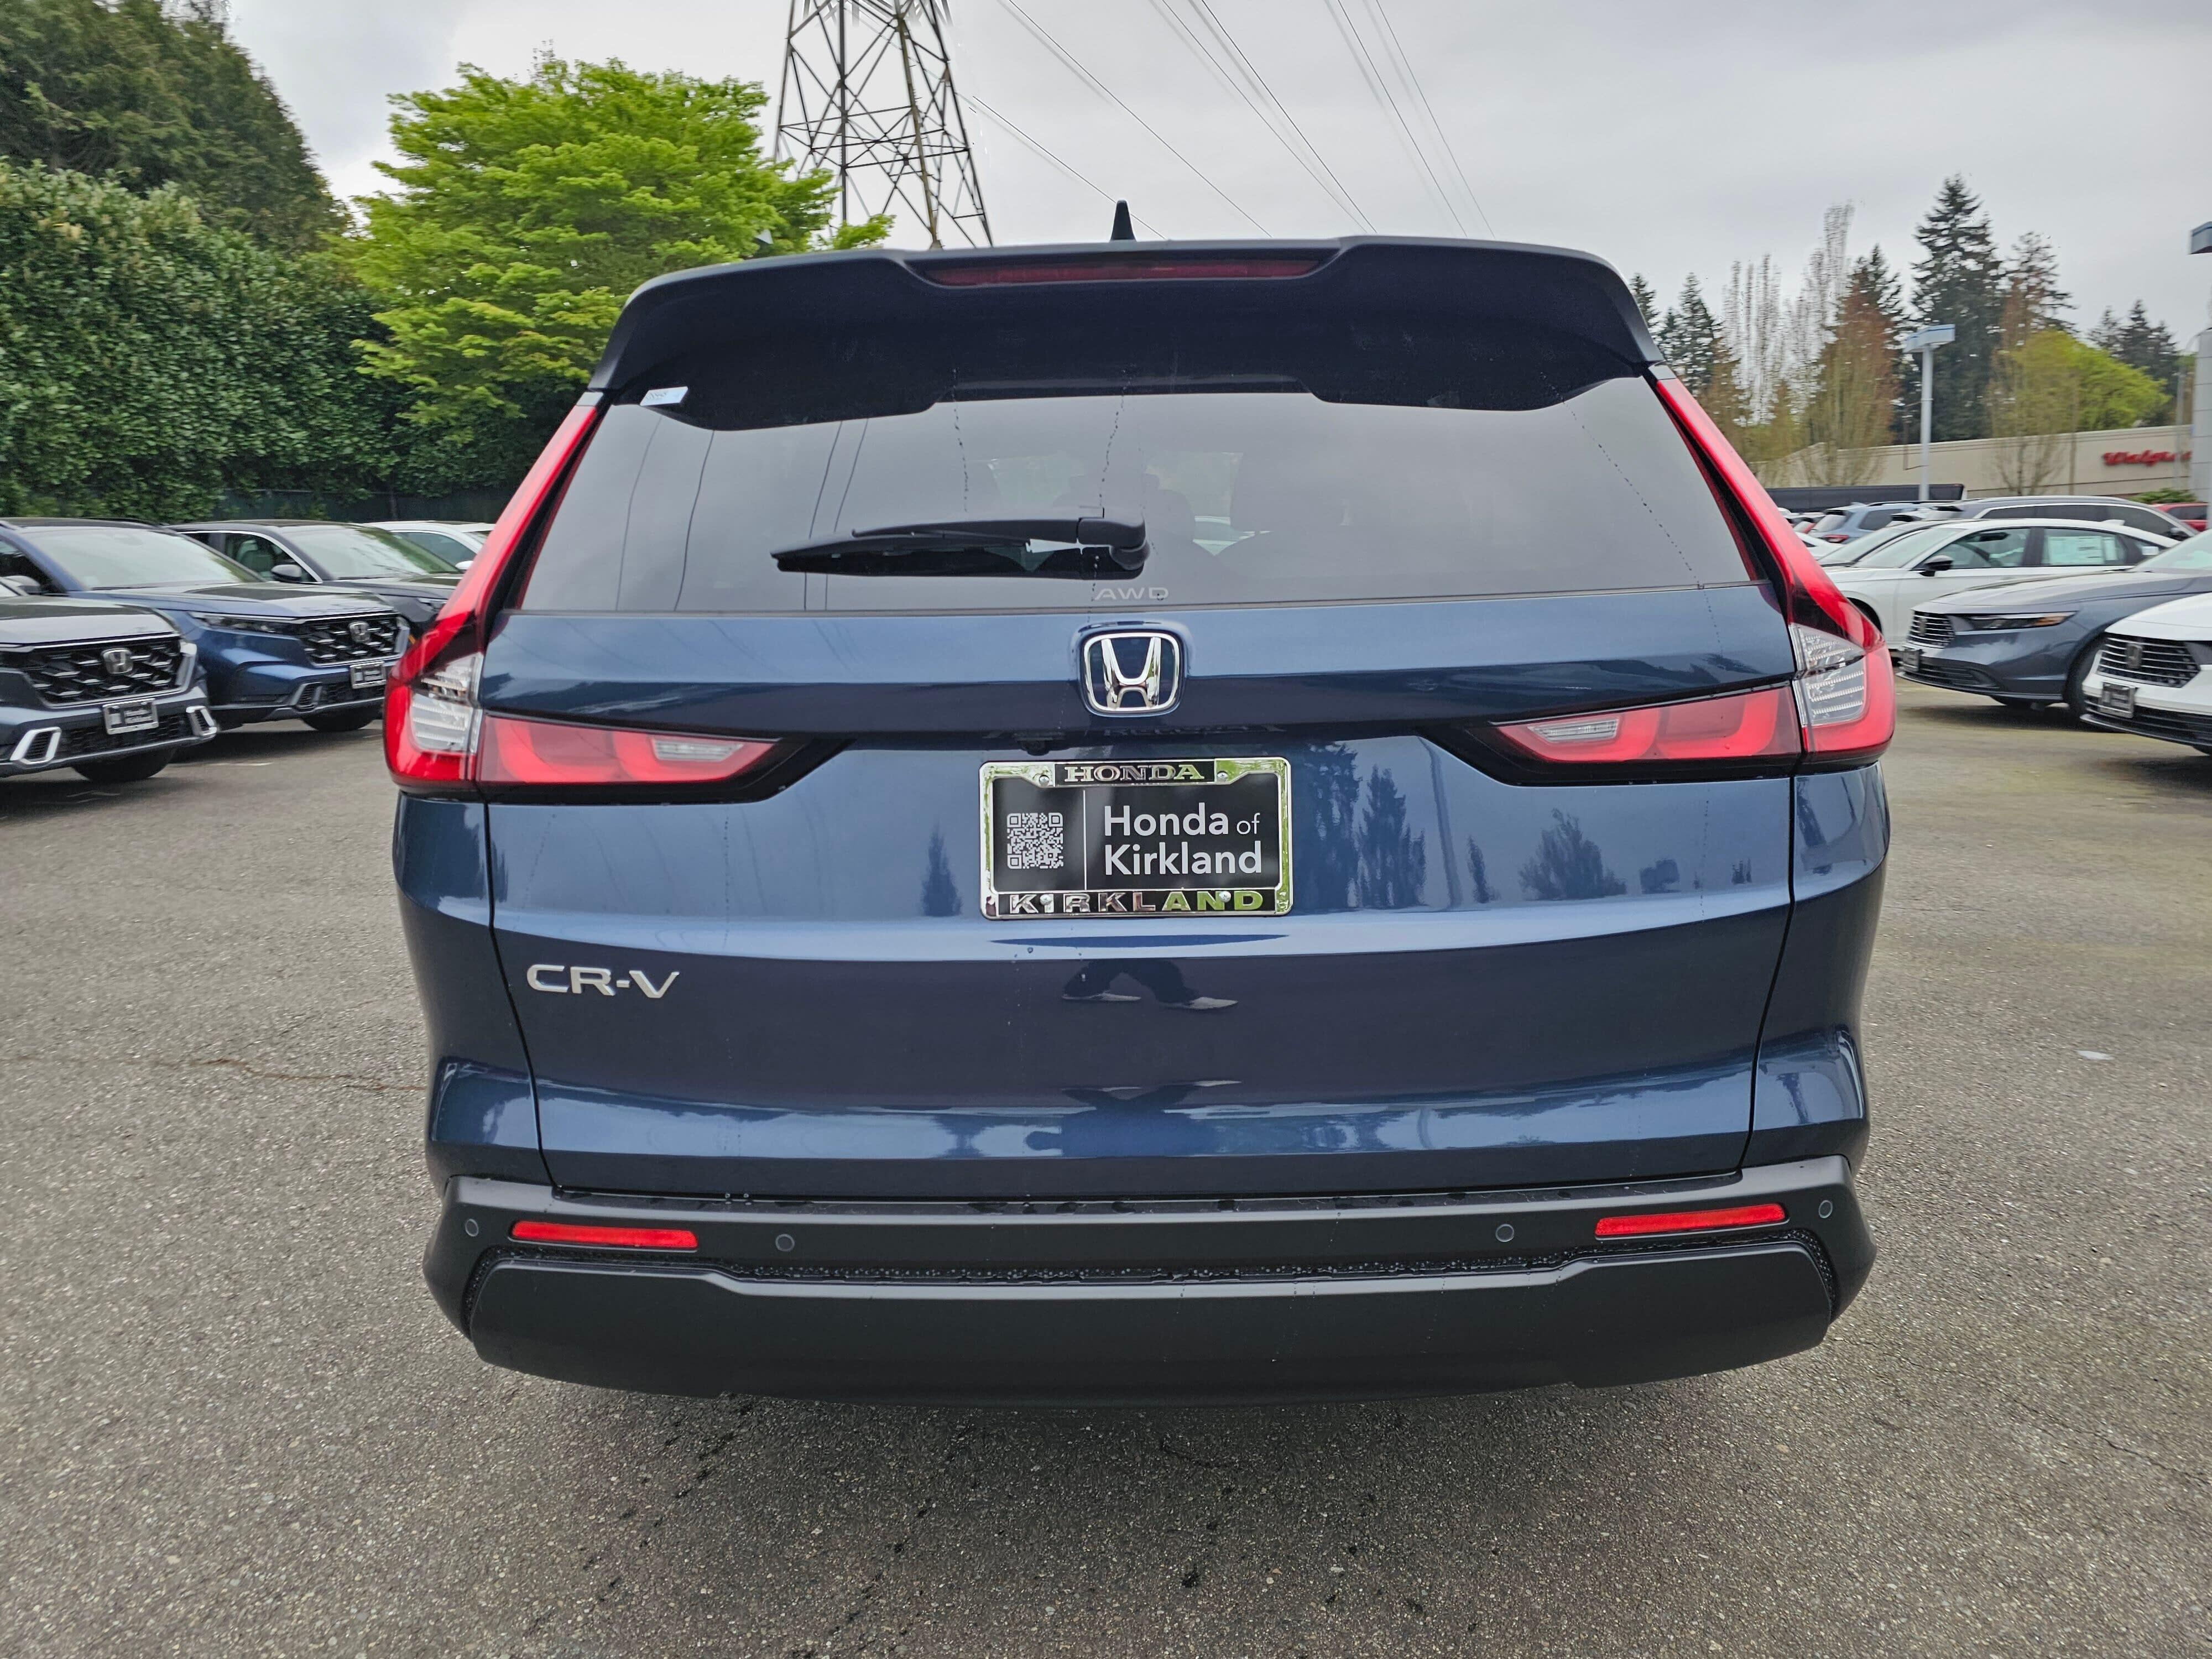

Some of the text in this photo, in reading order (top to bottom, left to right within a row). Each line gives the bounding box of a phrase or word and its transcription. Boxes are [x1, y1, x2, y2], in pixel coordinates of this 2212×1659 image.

[1094, 587, 1169, 601] AWD
[1063, 764, 1204, 782] HONDA
[1104, 802, 1260, 836] Honda of
[1105, 840, 1261, 875] Kirkland
[1009, 890, 1263, 913] KIRKLAND
[527, 964, 680, 998] CR-V
